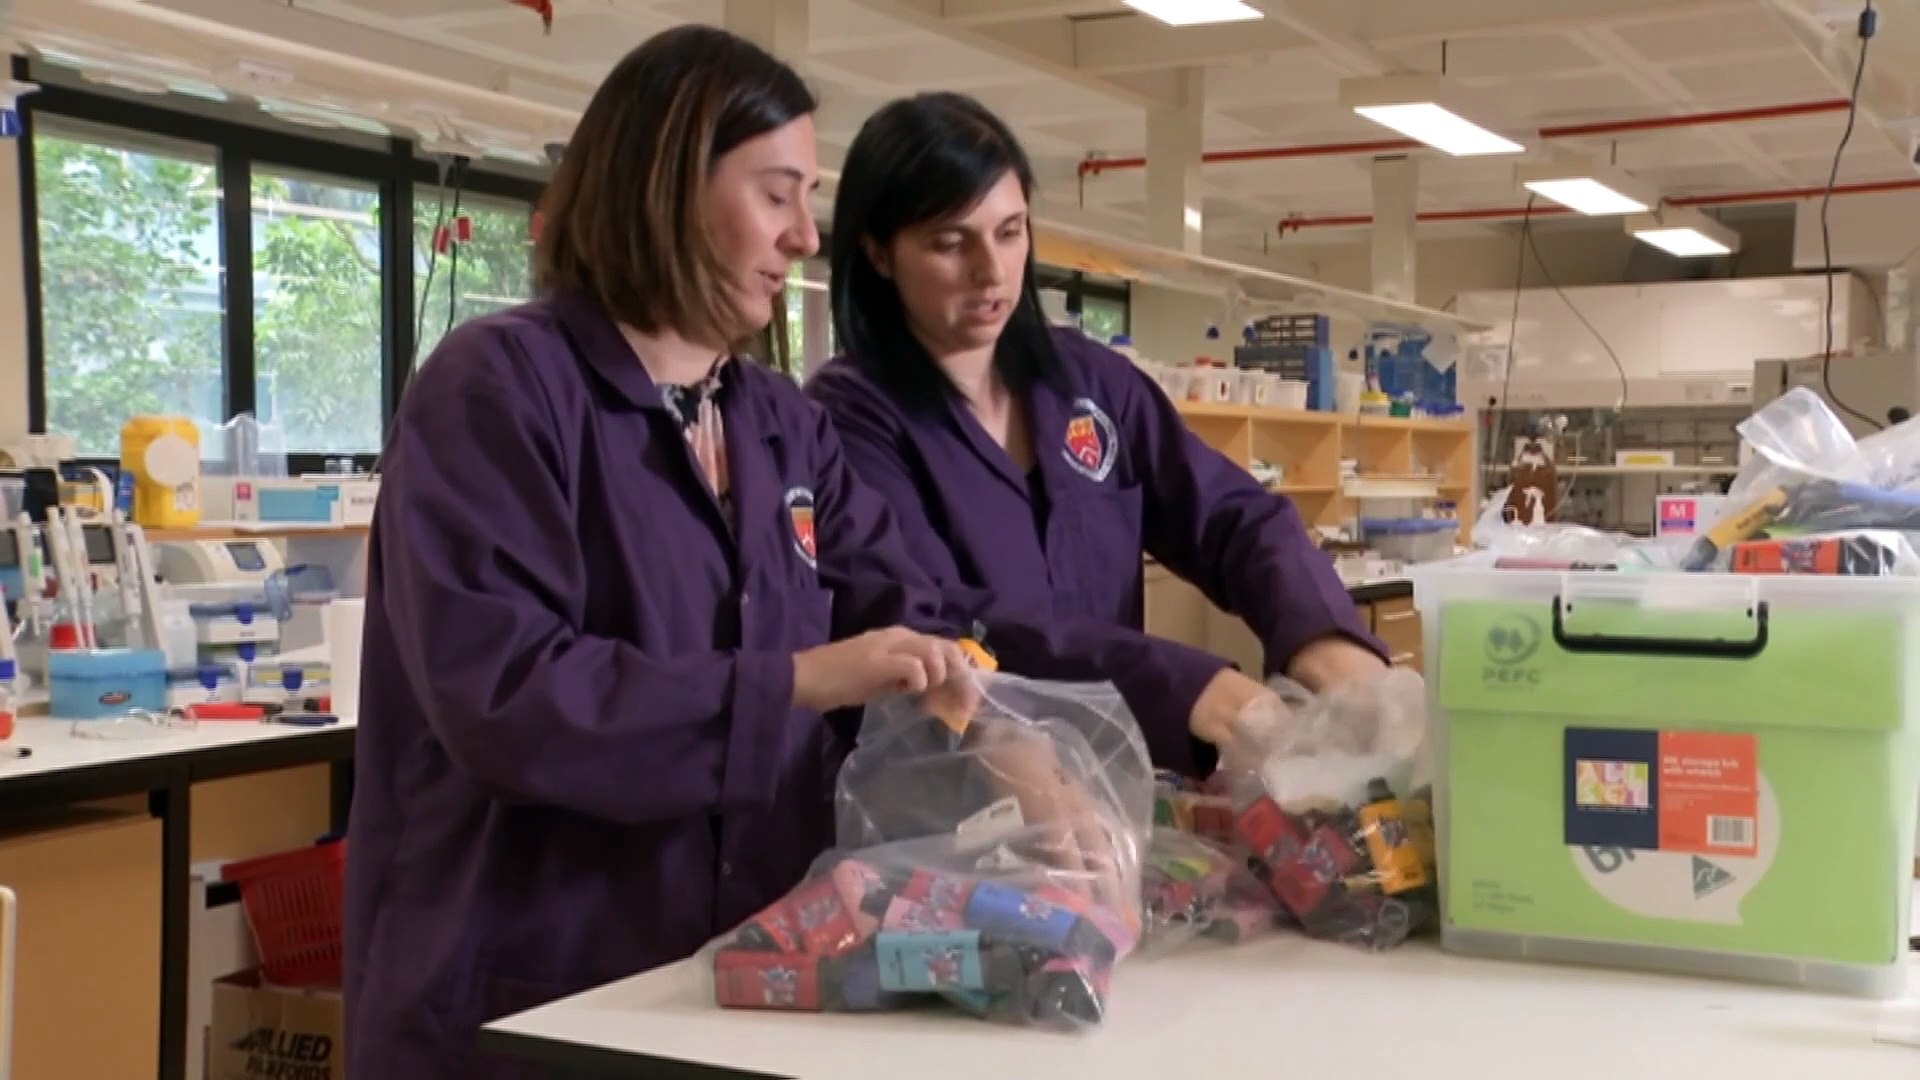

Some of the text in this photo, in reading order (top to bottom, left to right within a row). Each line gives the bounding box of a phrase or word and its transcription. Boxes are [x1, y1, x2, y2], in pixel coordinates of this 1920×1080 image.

[1669, 503, 1687, 518] M
[1482, 667, 1541, 684] PEFC
[229, 1026, 333, 1062] ALLIED
